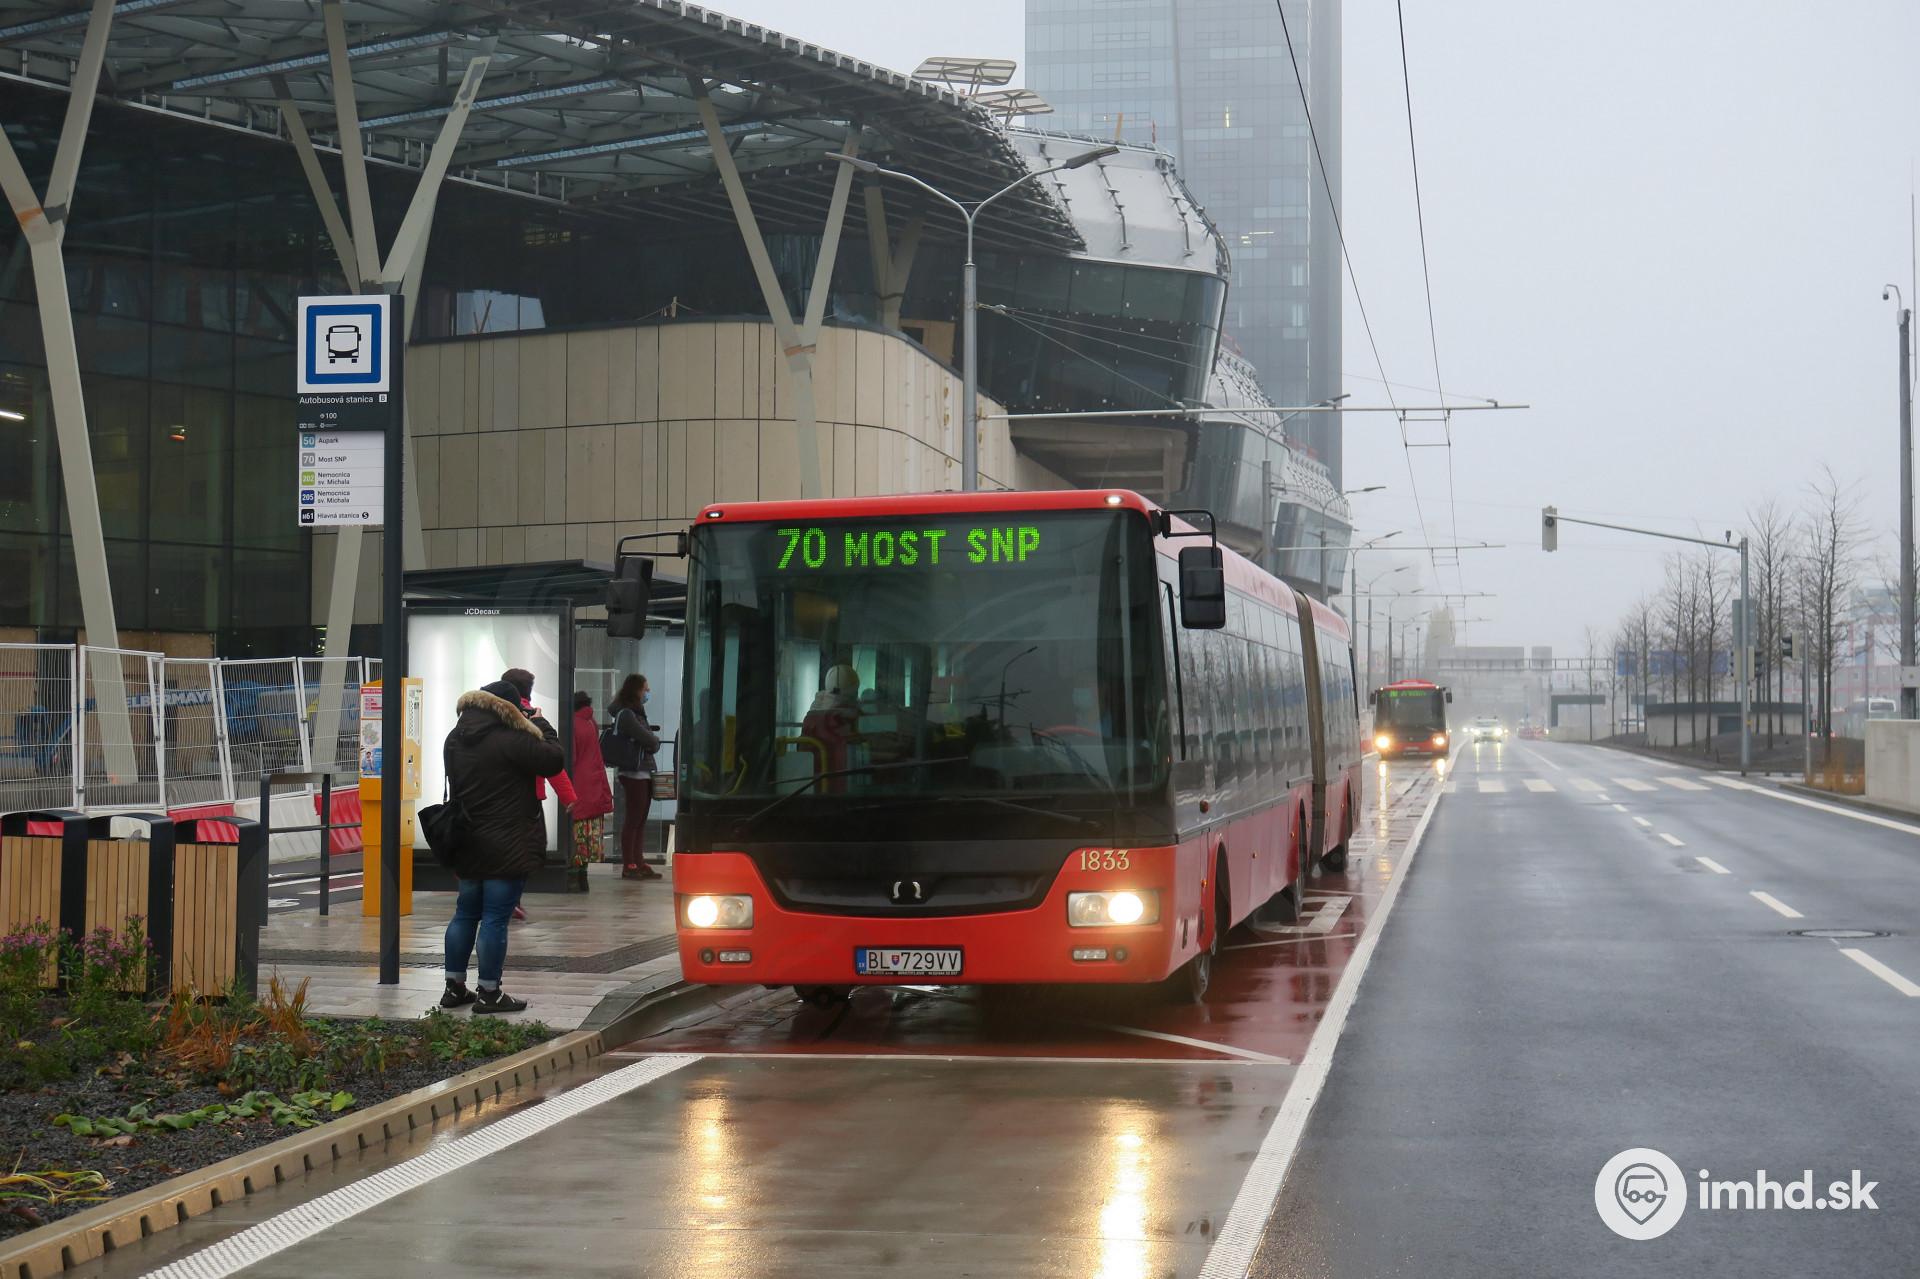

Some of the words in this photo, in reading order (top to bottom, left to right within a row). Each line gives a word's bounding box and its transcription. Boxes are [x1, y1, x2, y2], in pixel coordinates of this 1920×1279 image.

[299, 396, 344, 404] Autobusová
[346, 395, 374, 403] stanica
[303, 437, 315, 445] 50
[303, 455, 315, 463] 70
[302, 474, 315, 482] 202
[302, 493, 314, 501] 205
[777, 527, 827, 569] 70
[844, 529, 947, 567] MOST
[967, 526, 1041, 564] SNP
[464, 608, 501, 616] JCDecaux
[1080, 849, 1130, 871] 1833
